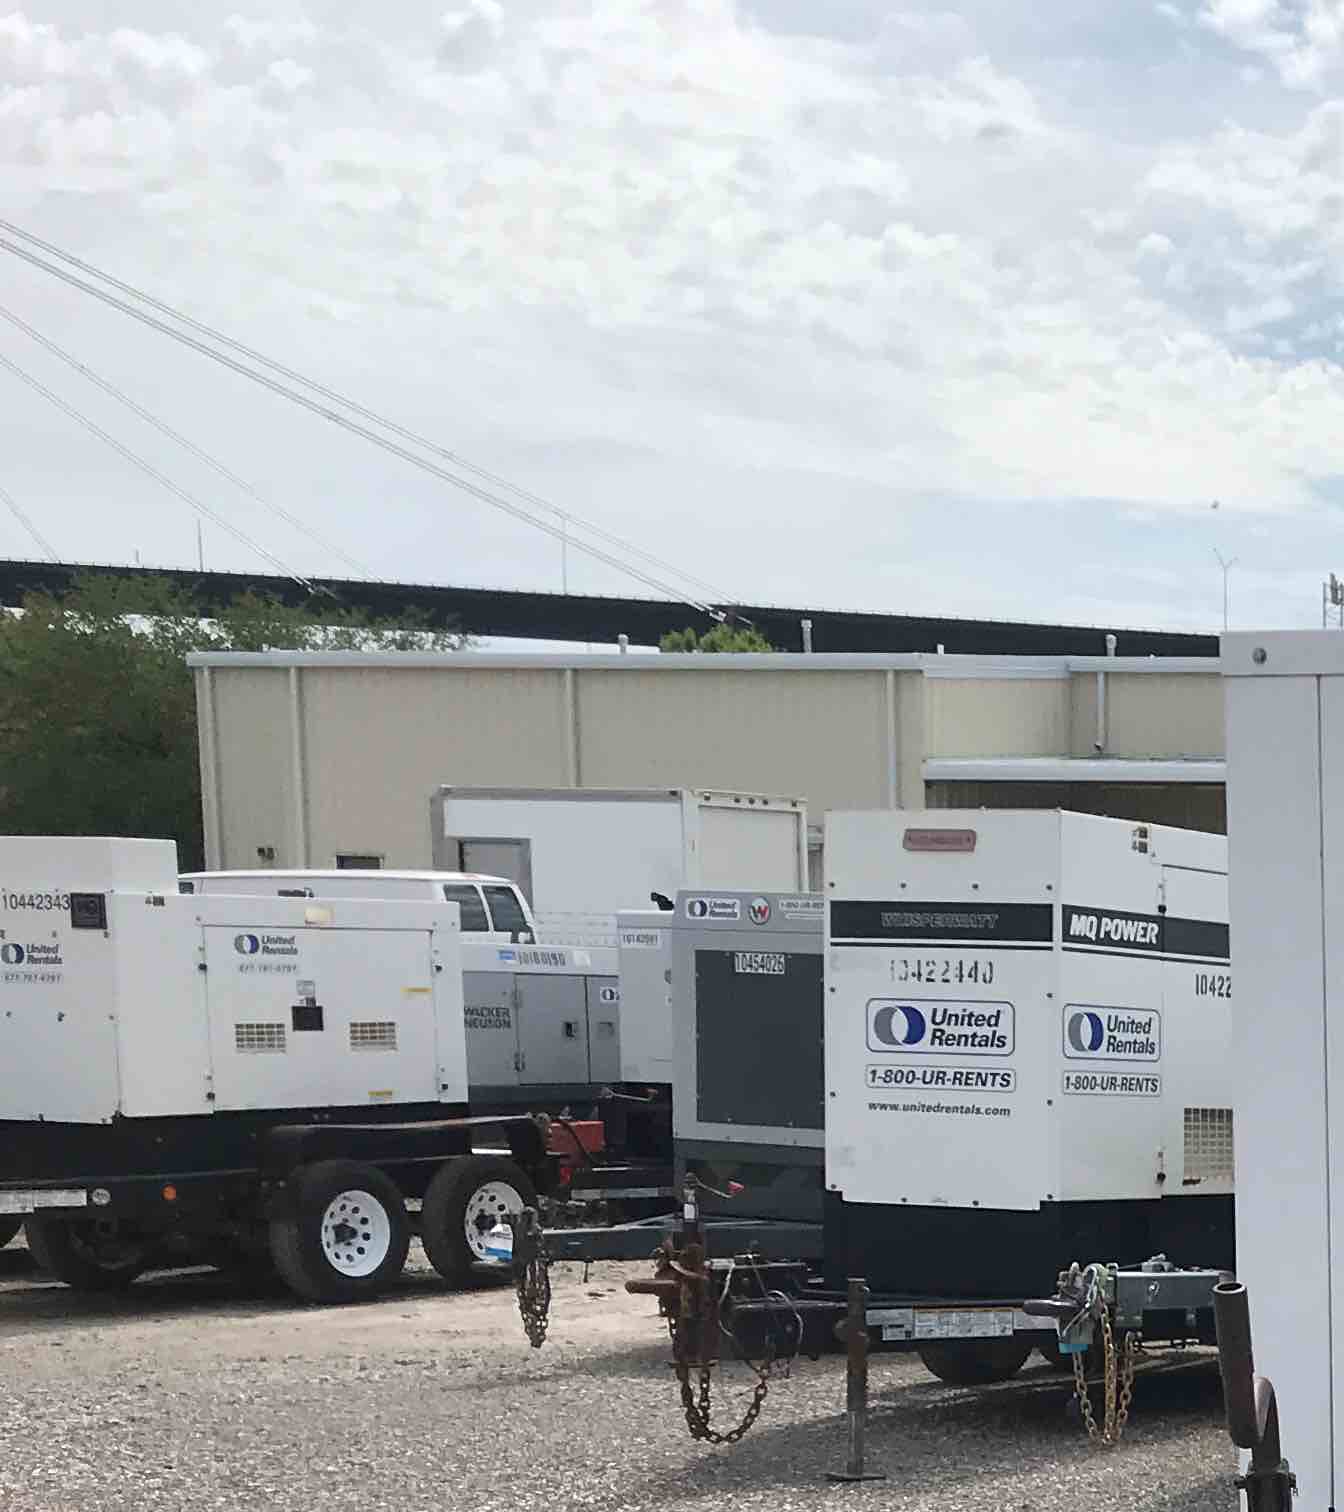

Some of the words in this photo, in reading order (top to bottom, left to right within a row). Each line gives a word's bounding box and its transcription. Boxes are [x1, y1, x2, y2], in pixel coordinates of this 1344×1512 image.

[2, 894, 70, 910] 10442343
[1070, 914, 1098, 941] MQ
[1100, 918, 1159, 944] POWER
[26, 944, 59, 954] United
[26, 955, 63, 965] Rentals
[1195, 974, 1231, 998] 10422
[464, 1007, 510, 1018] WACKER
[931, 1008, 1001, 1028] United
[464, 1018, 512, 1029] NEUSON
[1107, 1015, 1152, 1034] United
[930, 1028, 1007, 1048] Rentals
[1106, 1035, 1155, 1054] Rentals
[870, 1069, 1012, 1088] 1-800-UR-RENTS
[1065, 1076, 1159, 1093] 1-800-UR-RENTS
[868, 1102, 1011, 1116] www.unitedrentals.com
